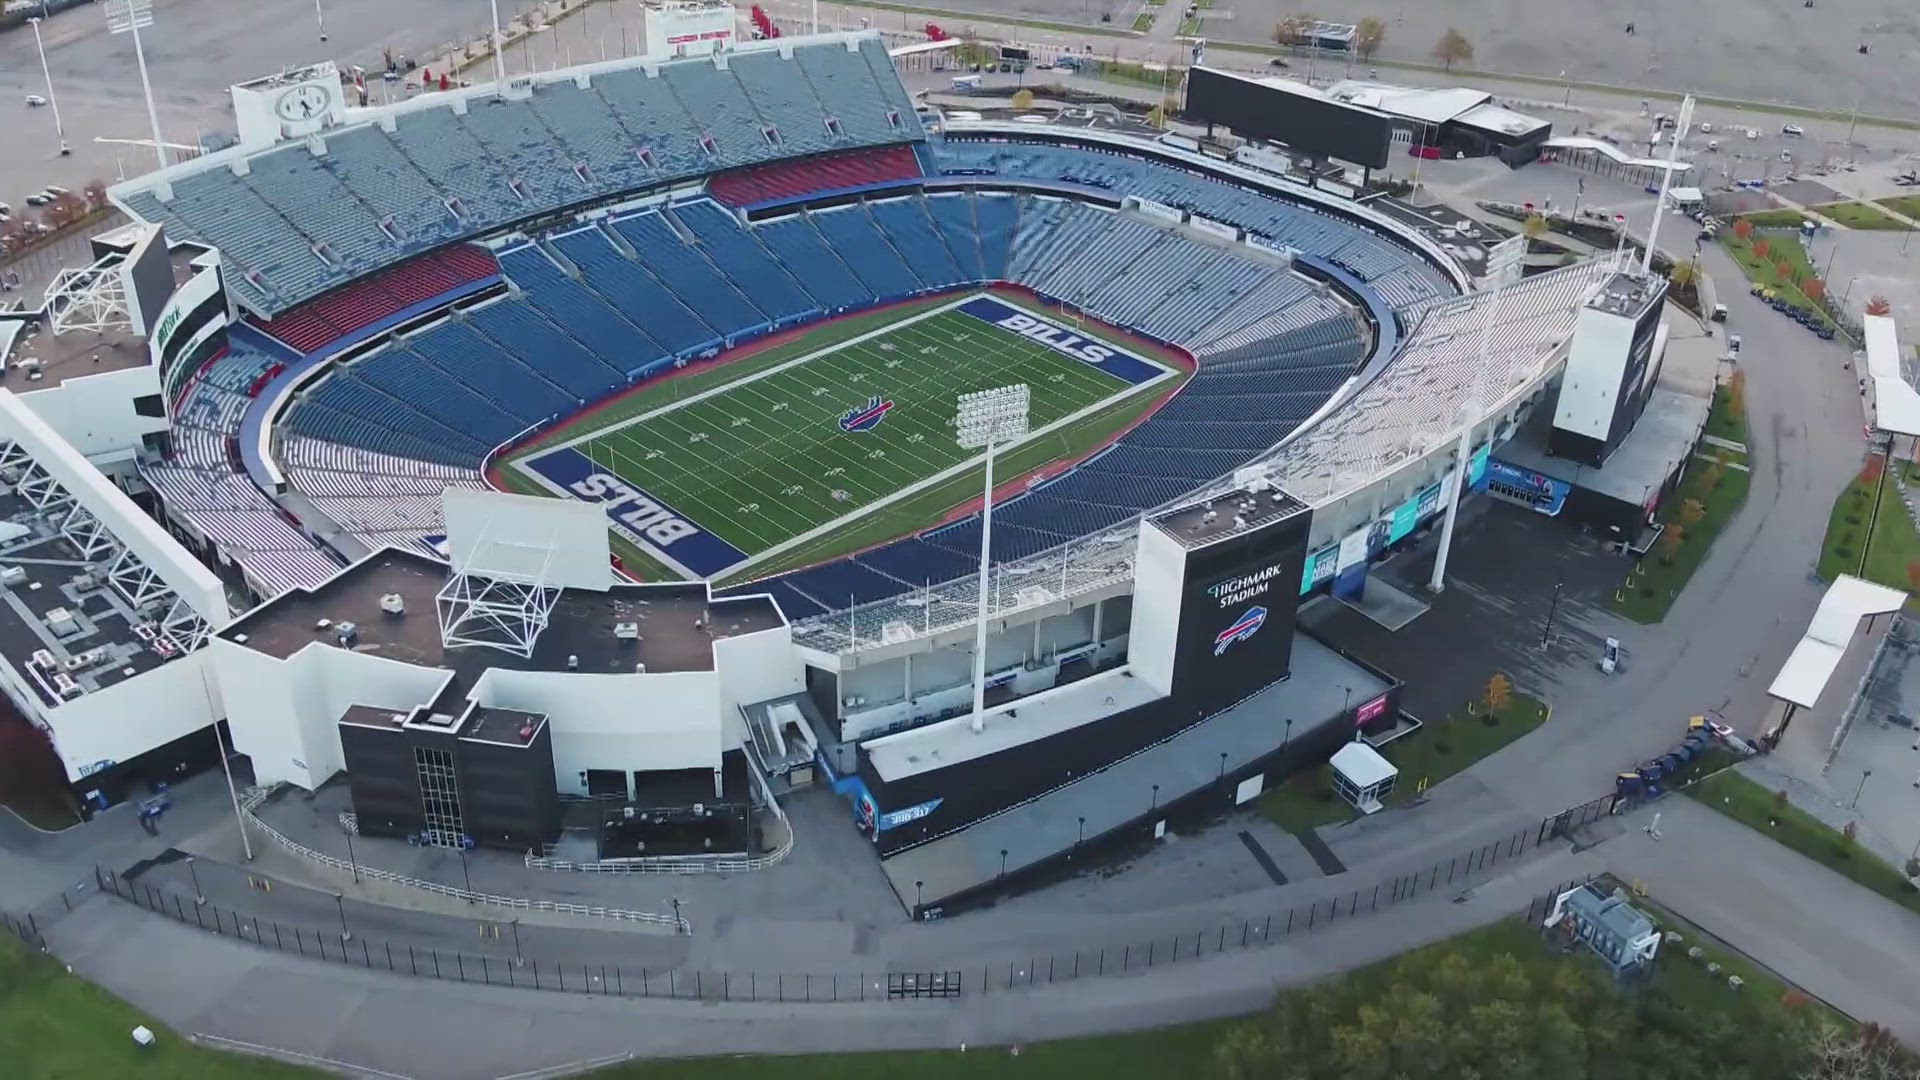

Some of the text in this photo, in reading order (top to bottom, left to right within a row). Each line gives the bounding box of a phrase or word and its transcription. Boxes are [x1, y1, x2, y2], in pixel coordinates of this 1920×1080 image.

[996, 313, 1116, 363] BILLS
[569, 473, 699, 546] BILLS
[1208, 563, 1282, 598] HIGHMARK
[1220, 581, 1269, 608] STADIUM
